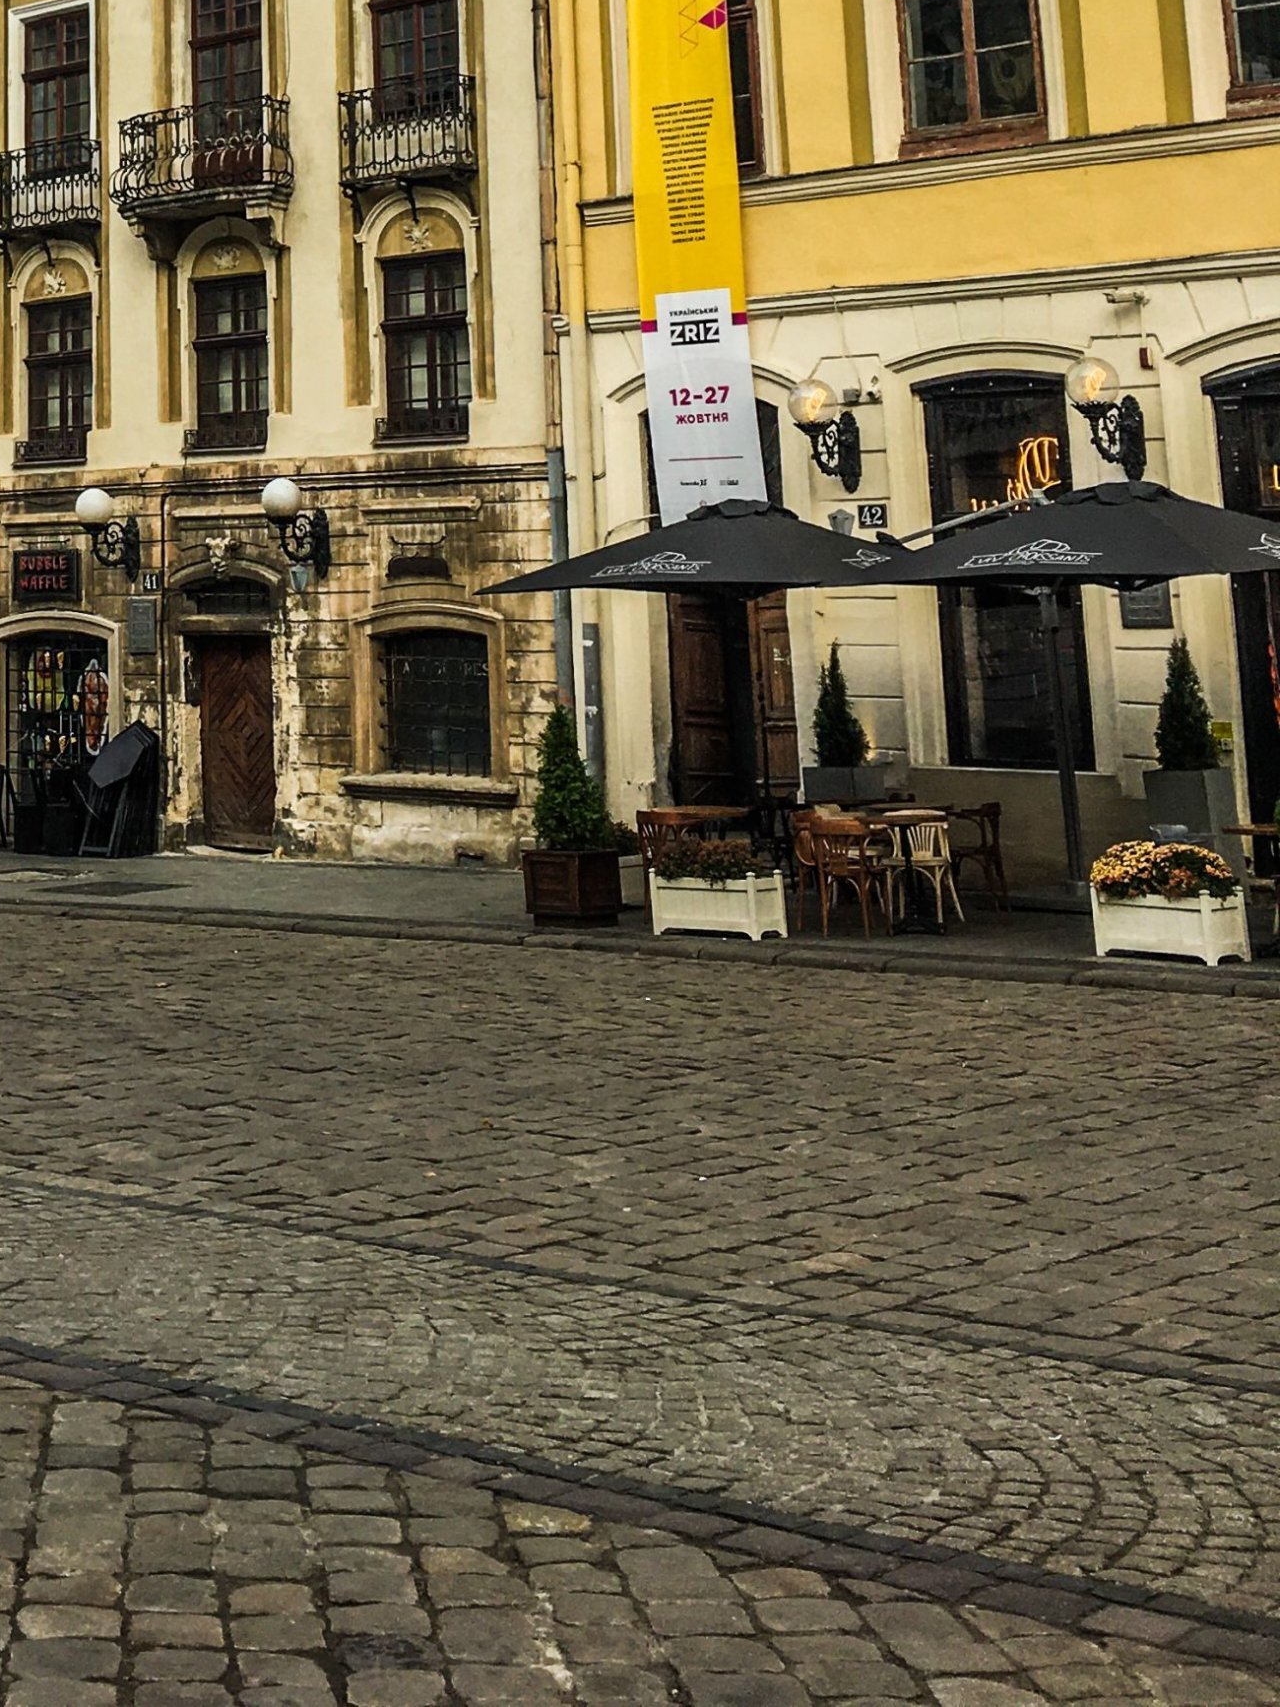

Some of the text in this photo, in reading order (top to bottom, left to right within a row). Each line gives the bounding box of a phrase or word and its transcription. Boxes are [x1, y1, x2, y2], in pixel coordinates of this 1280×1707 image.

[669, 305, 719, 317] УКРАЇНСЬКИЙ
[670, 322, 720, 343] ZRIZ
[669, 385, 730, 406] 12-27
[675, 412, 729, 425] ЖОВТНЯ
[861, 505, 883, 526] 42
[20, 555, 69, 571] BUBBLE
[20, 573, 69, 590] WAFFLE
[144, 574, 158, 590] 41
